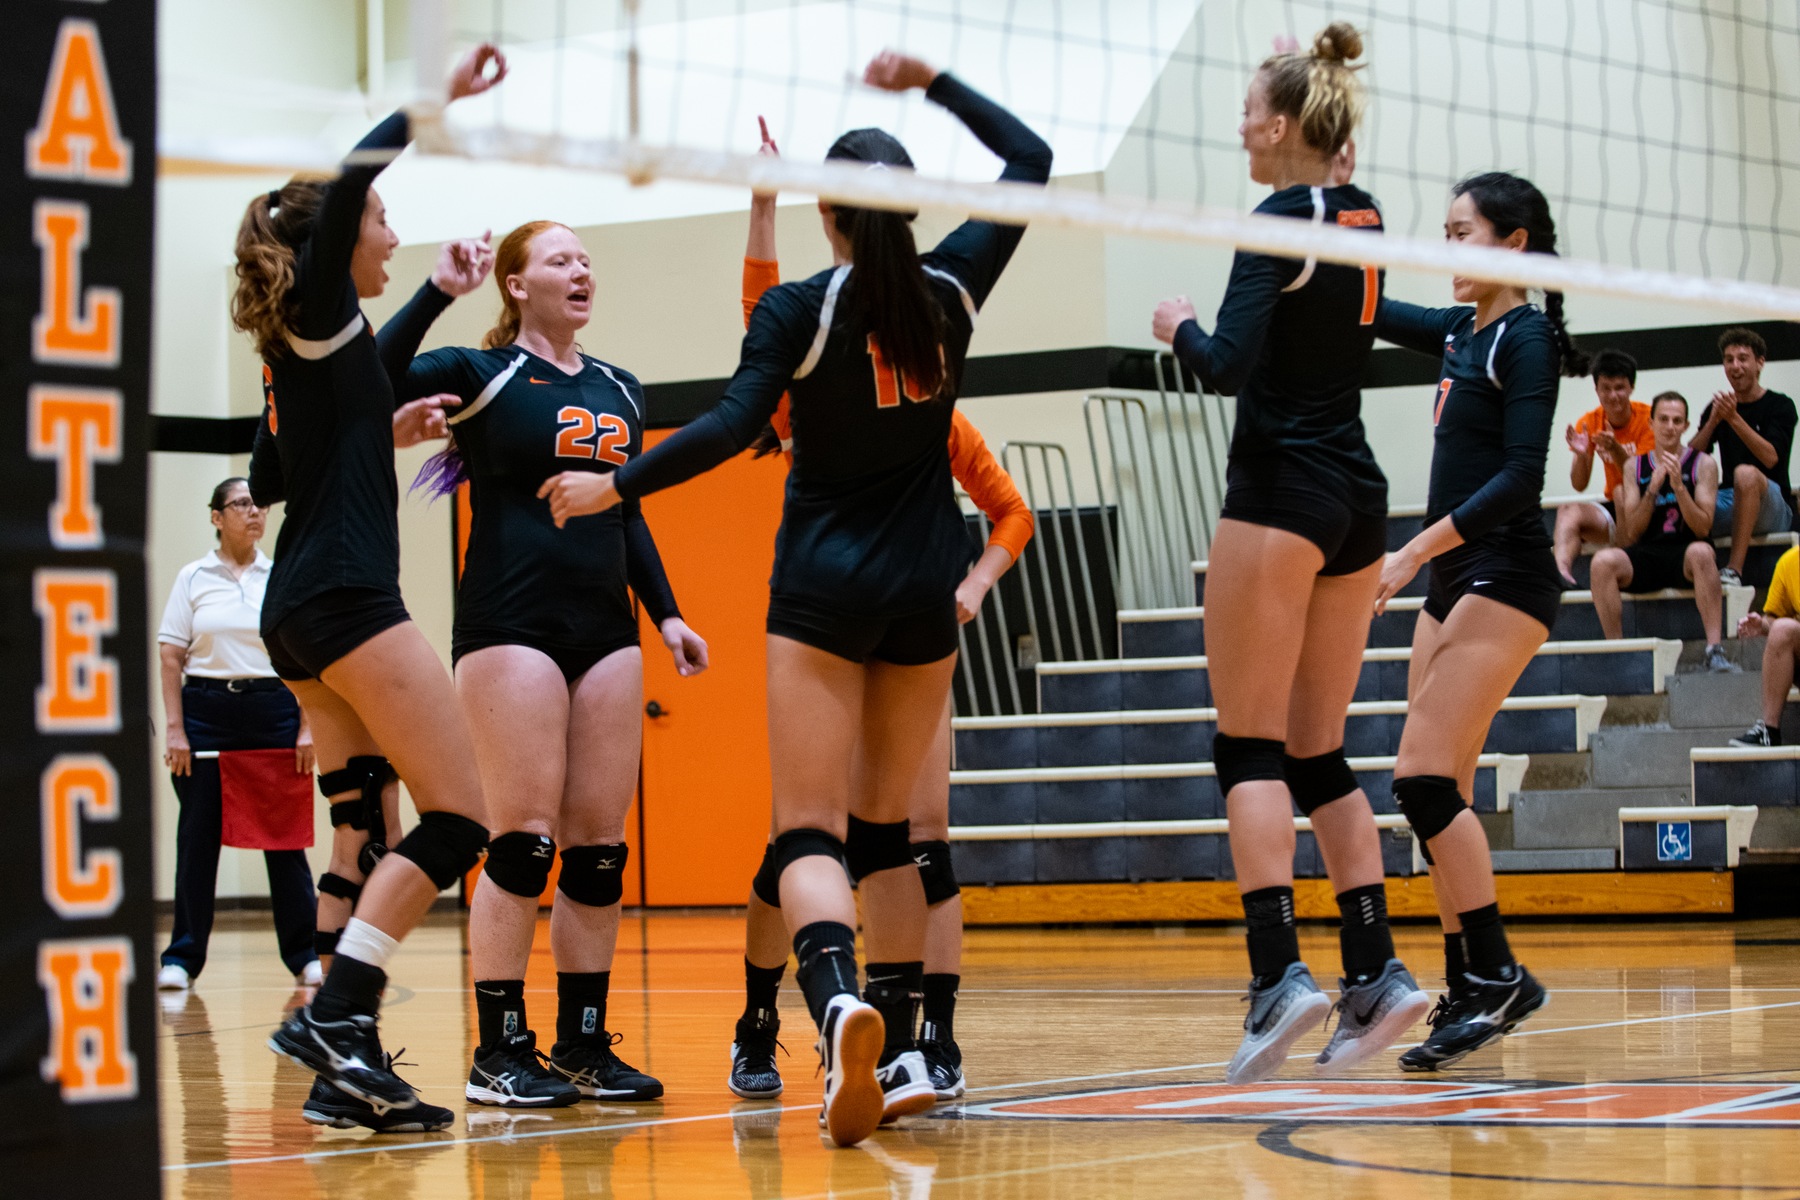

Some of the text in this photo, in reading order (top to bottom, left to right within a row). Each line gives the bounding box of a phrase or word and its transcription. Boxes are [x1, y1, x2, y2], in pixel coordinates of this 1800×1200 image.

[555, 405, 631, 467] 22
[1663, 507, 1679, 532] 2
[26, 0, 139, 1102] ALTECH
